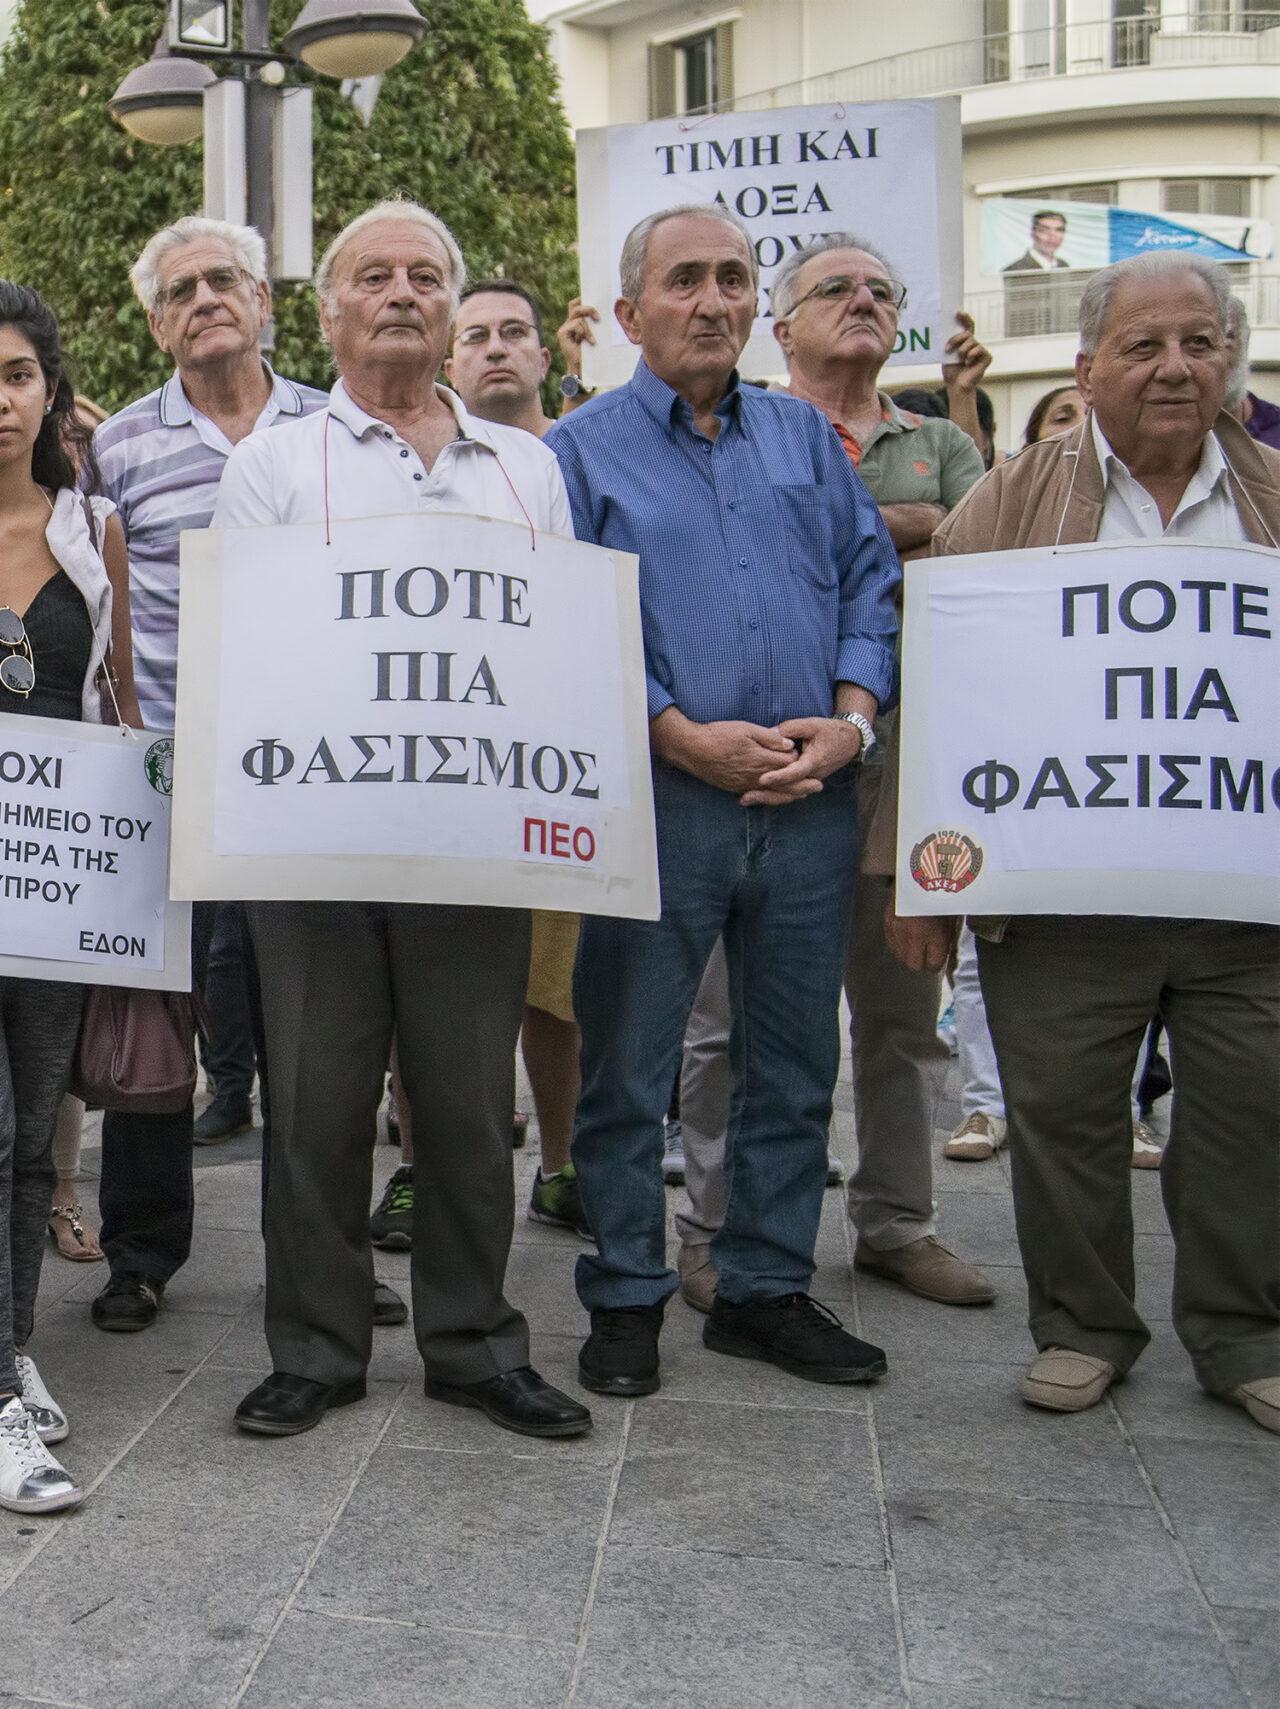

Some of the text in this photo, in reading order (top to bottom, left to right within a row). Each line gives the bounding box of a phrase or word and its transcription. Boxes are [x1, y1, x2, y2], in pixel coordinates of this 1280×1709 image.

[656, 127, 880, 175] ΤΙΜΗ ΚΑΙ
[334, 566, 532, 628] ΠΟΤΕ
[1062, 580, 1271, 639] ΠΟΤΕ
[370, 651, 507, 707] ΠΙΑ
[1104, 666, 1240, 723] ΠΙΑ
[241, 734, 600, 801] ΦΑΣΙΣΜΟΣ
[961, 754, 1280, 814] ΦΑΣΙΣΜ
[100, 815, 152, 842] ΤΟΥ
[523, 817, 596, 862] ΠΕΟ
[69, 846, 119, 874] ΤΗΣ
[79, 931, 145, 957] ΕΔΟΝ
